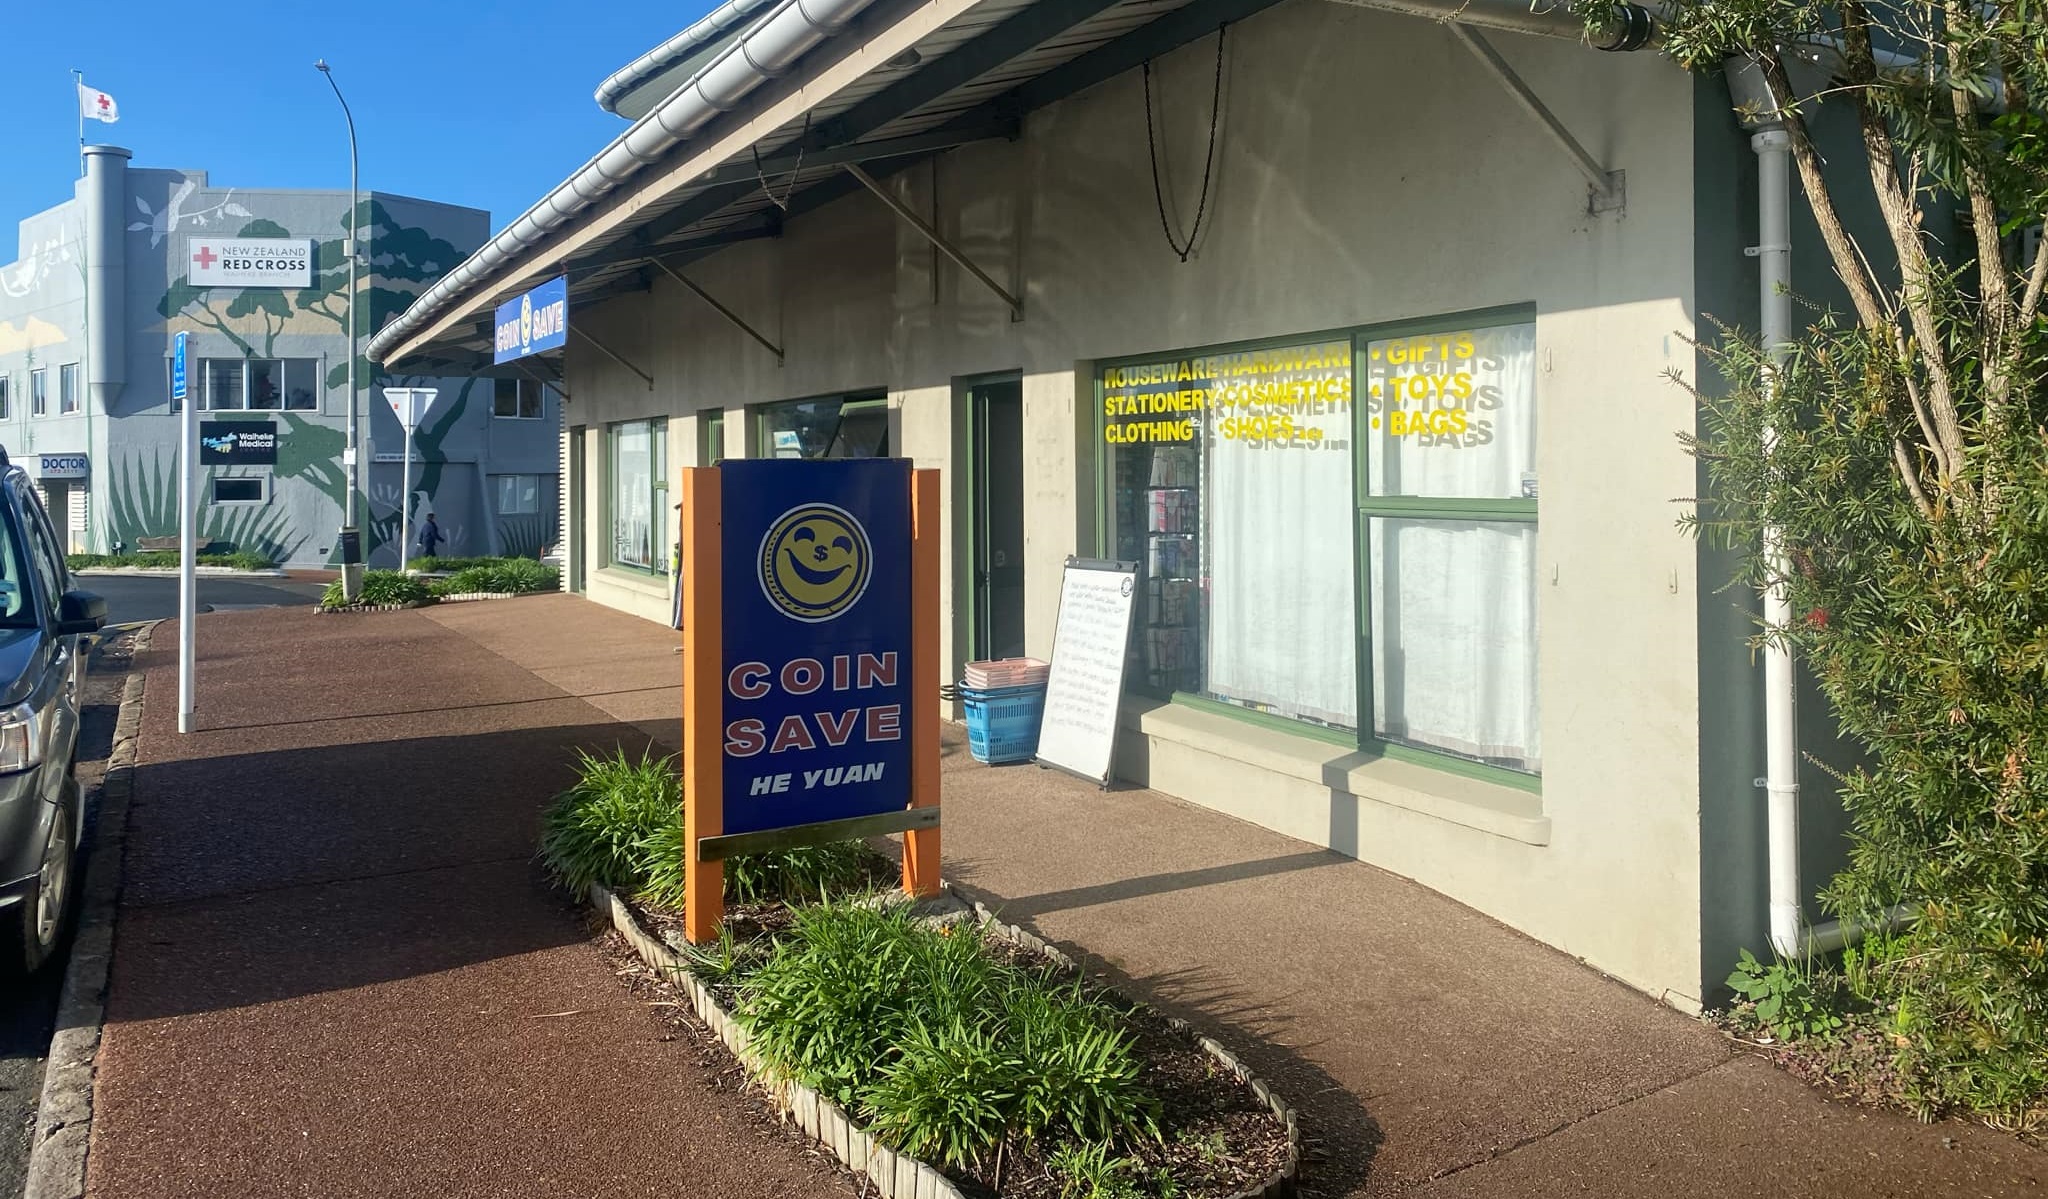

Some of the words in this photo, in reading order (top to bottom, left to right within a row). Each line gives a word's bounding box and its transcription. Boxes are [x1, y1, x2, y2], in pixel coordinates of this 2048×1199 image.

[222, 247, 250, 256] NEW
[253, 247, 306, 257] ZEALAND
[223, 260, 252, 270] RED
[255, 260, 306, 271] CROSS
[496, 318, 520, 353] COIN
[532, 300, 564, 341] SAVE
[1386, 332, 1475, 365] GIFTS
[1104, 357, 1219, 389] HOUSEWARE
[1388, 372, 1473, 402] TOYS
[1104, 388, 1220, 416] STATIONERY
[1223, 377, 1352, 407] COSMETICS
[239, 433, 274, 441] Waiheke
[1104, 419, 1194, 443] CLOTHING
[1389, 408, 1468, 436] BAGS
[239, 440, 274, 448] Medical
[42, 458, 86, 469] DOCTOR
[727, 651, 899, 700] COIN
[723, 704, 901, 758] SAVE
[749, 773, 793, 797] HE
[803, 762, 886, 790] YUAN
